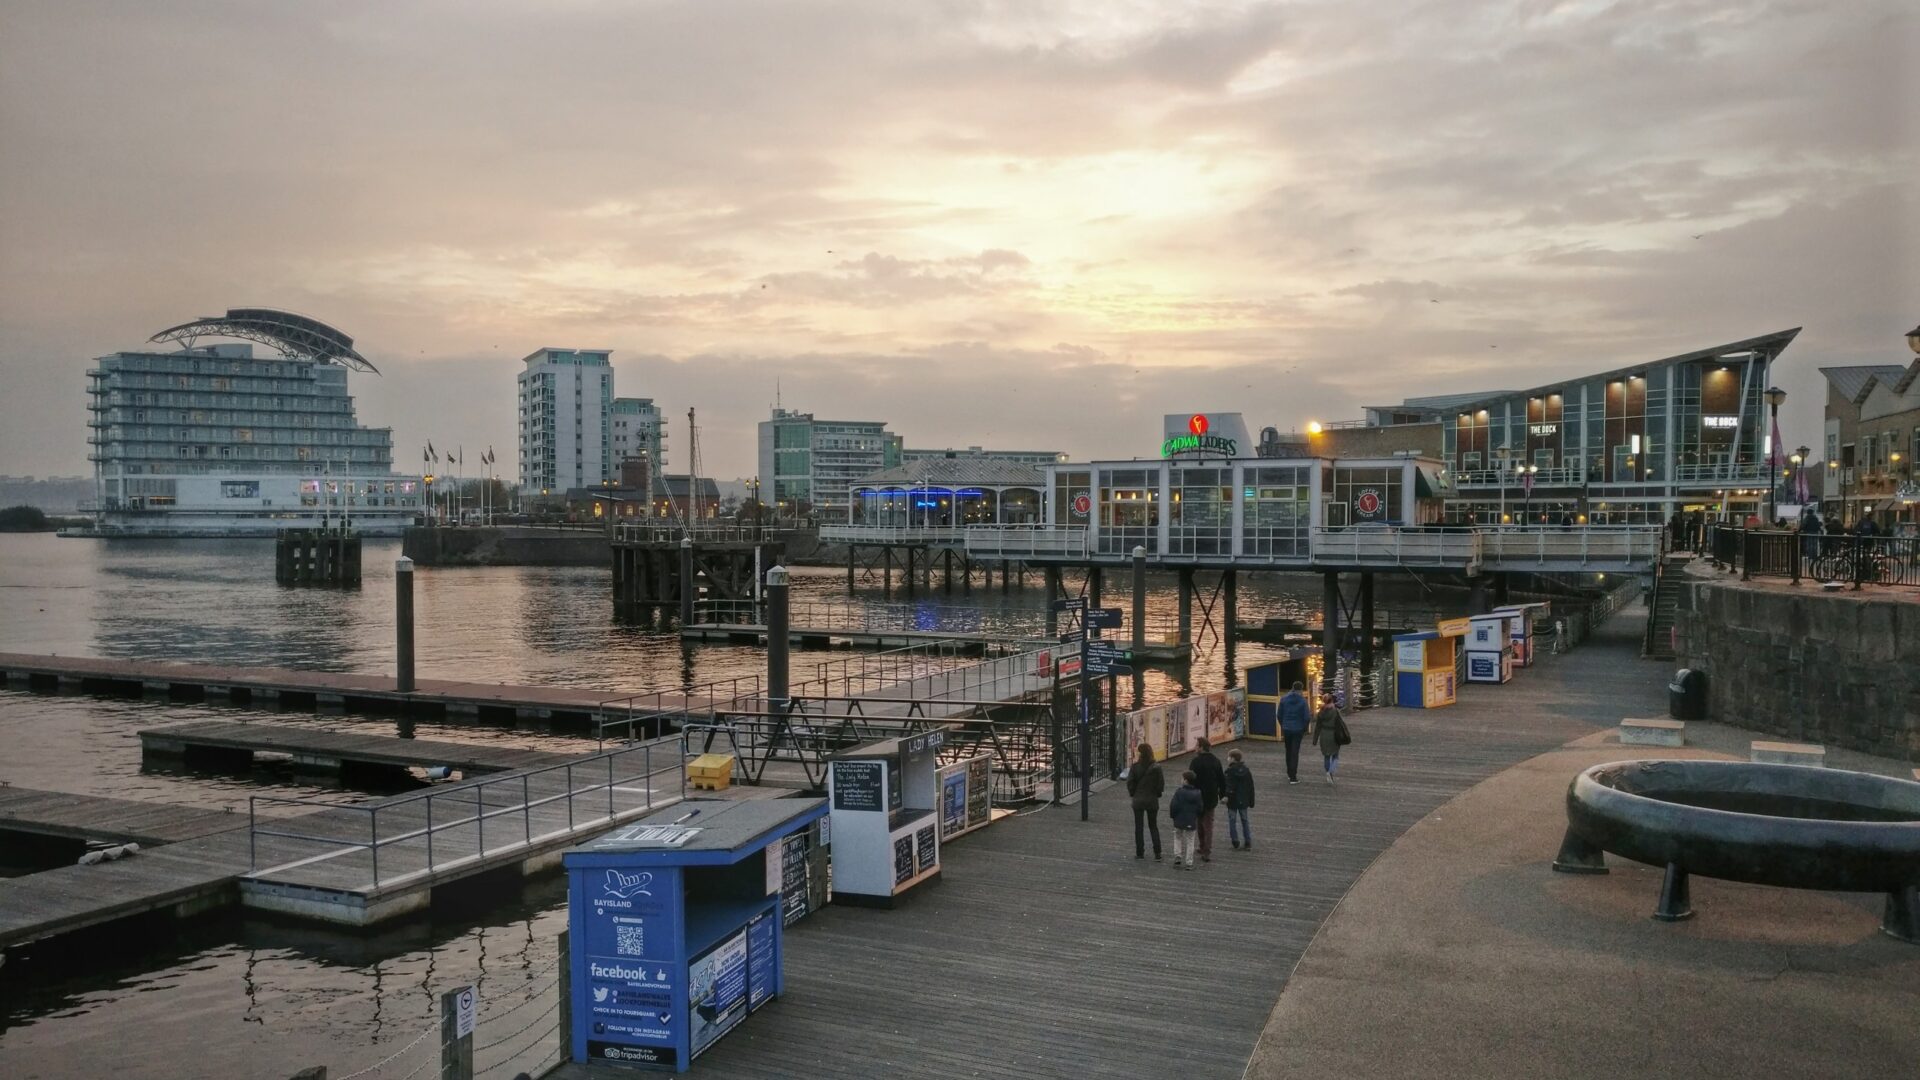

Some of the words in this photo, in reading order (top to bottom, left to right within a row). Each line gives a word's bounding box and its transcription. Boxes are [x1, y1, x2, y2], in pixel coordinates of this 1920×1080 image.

[1704, 417, 1717, 426] THE
[1530, 425, 1541, 434] THE
[1542, 424, 1557, 433] DOCK
[1160, 435, 1236, 457] CADWALADERS
[908, 738, 925, 753] LADY
[927, 732, 944, 746] HELEN
[590, 962, 647, 981] facebook
[621, 1051, 658, 1061] tripadvisor
